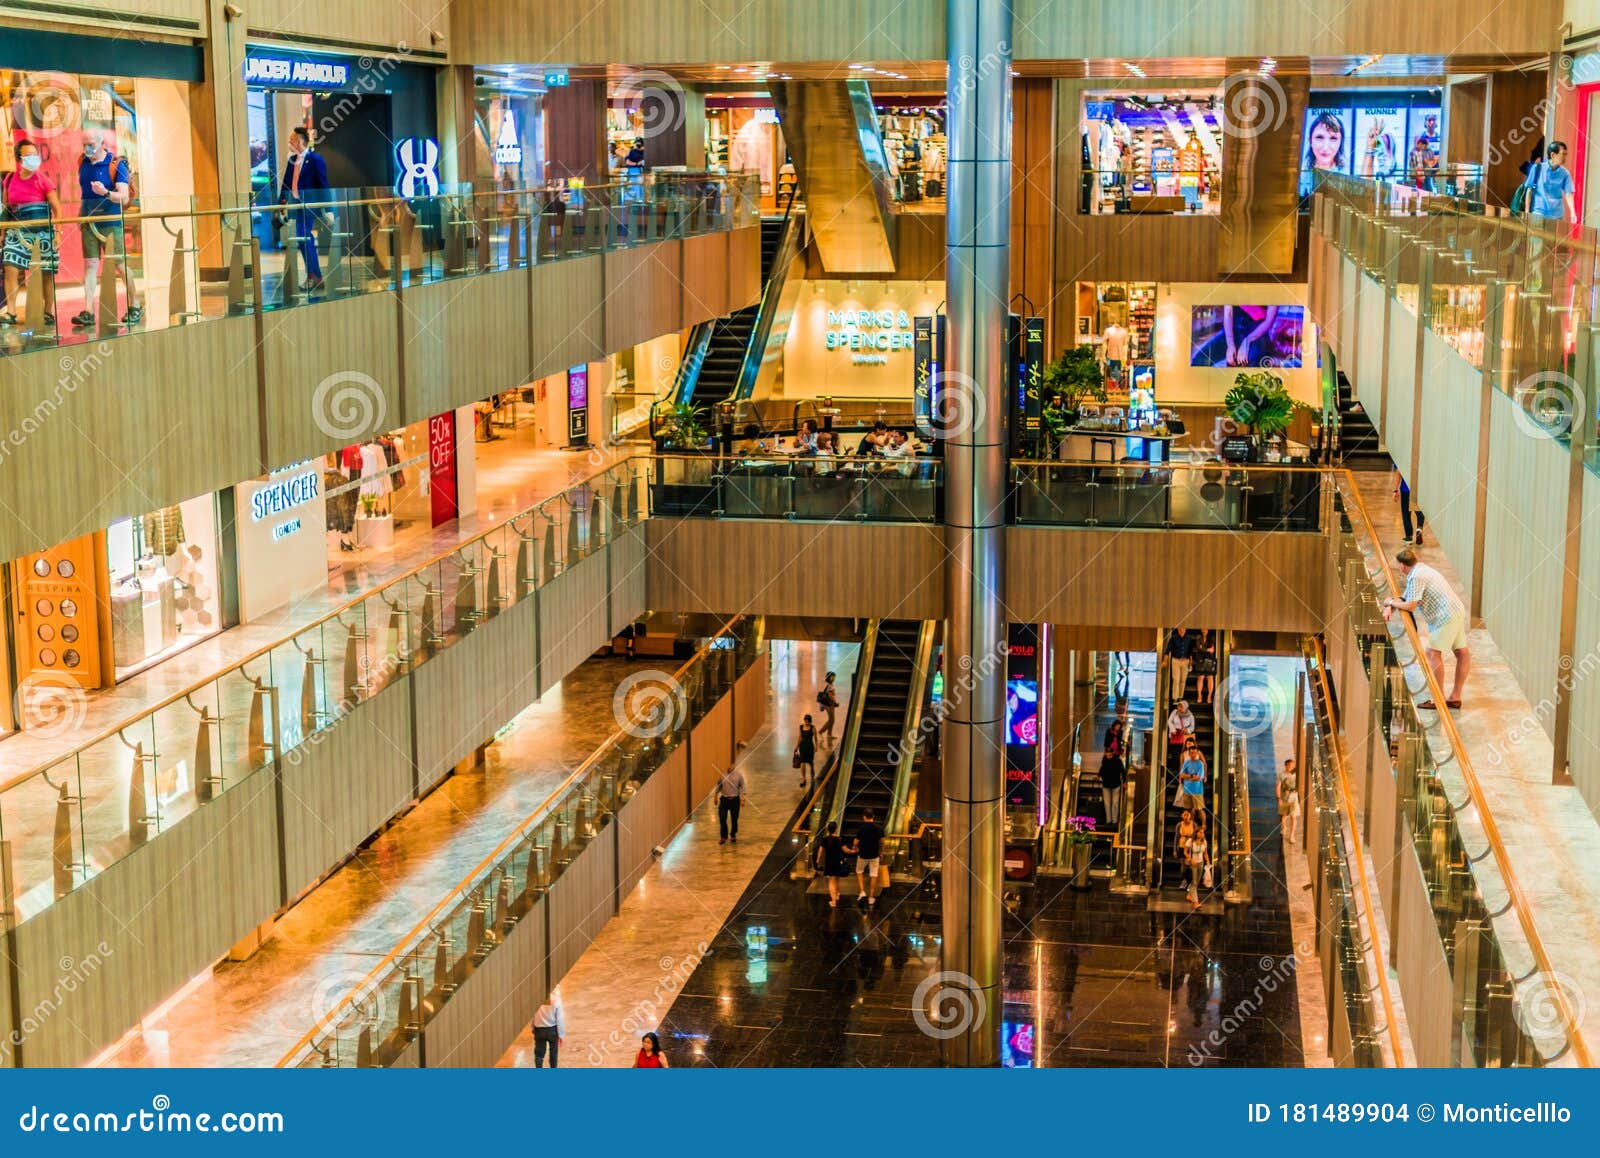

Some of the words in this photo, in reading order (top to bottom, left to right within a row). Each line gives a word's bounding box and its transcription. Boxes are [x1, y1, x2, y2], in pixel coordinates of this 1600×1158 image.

[245, 58, 290, 80] UNDER
[292, 62, 347, 84] ARMOUR
[828, 310, 894, 329] MARKS
[897, 310, 910, 329] &
[826, 331, 913, 350] SPENCER
[431, 416, 450, 444] 50%
[431, 441, 451, 468] OFF
[252, 470, 319, 520] SPENCER
[273, 519, 302, 539] LONDON
